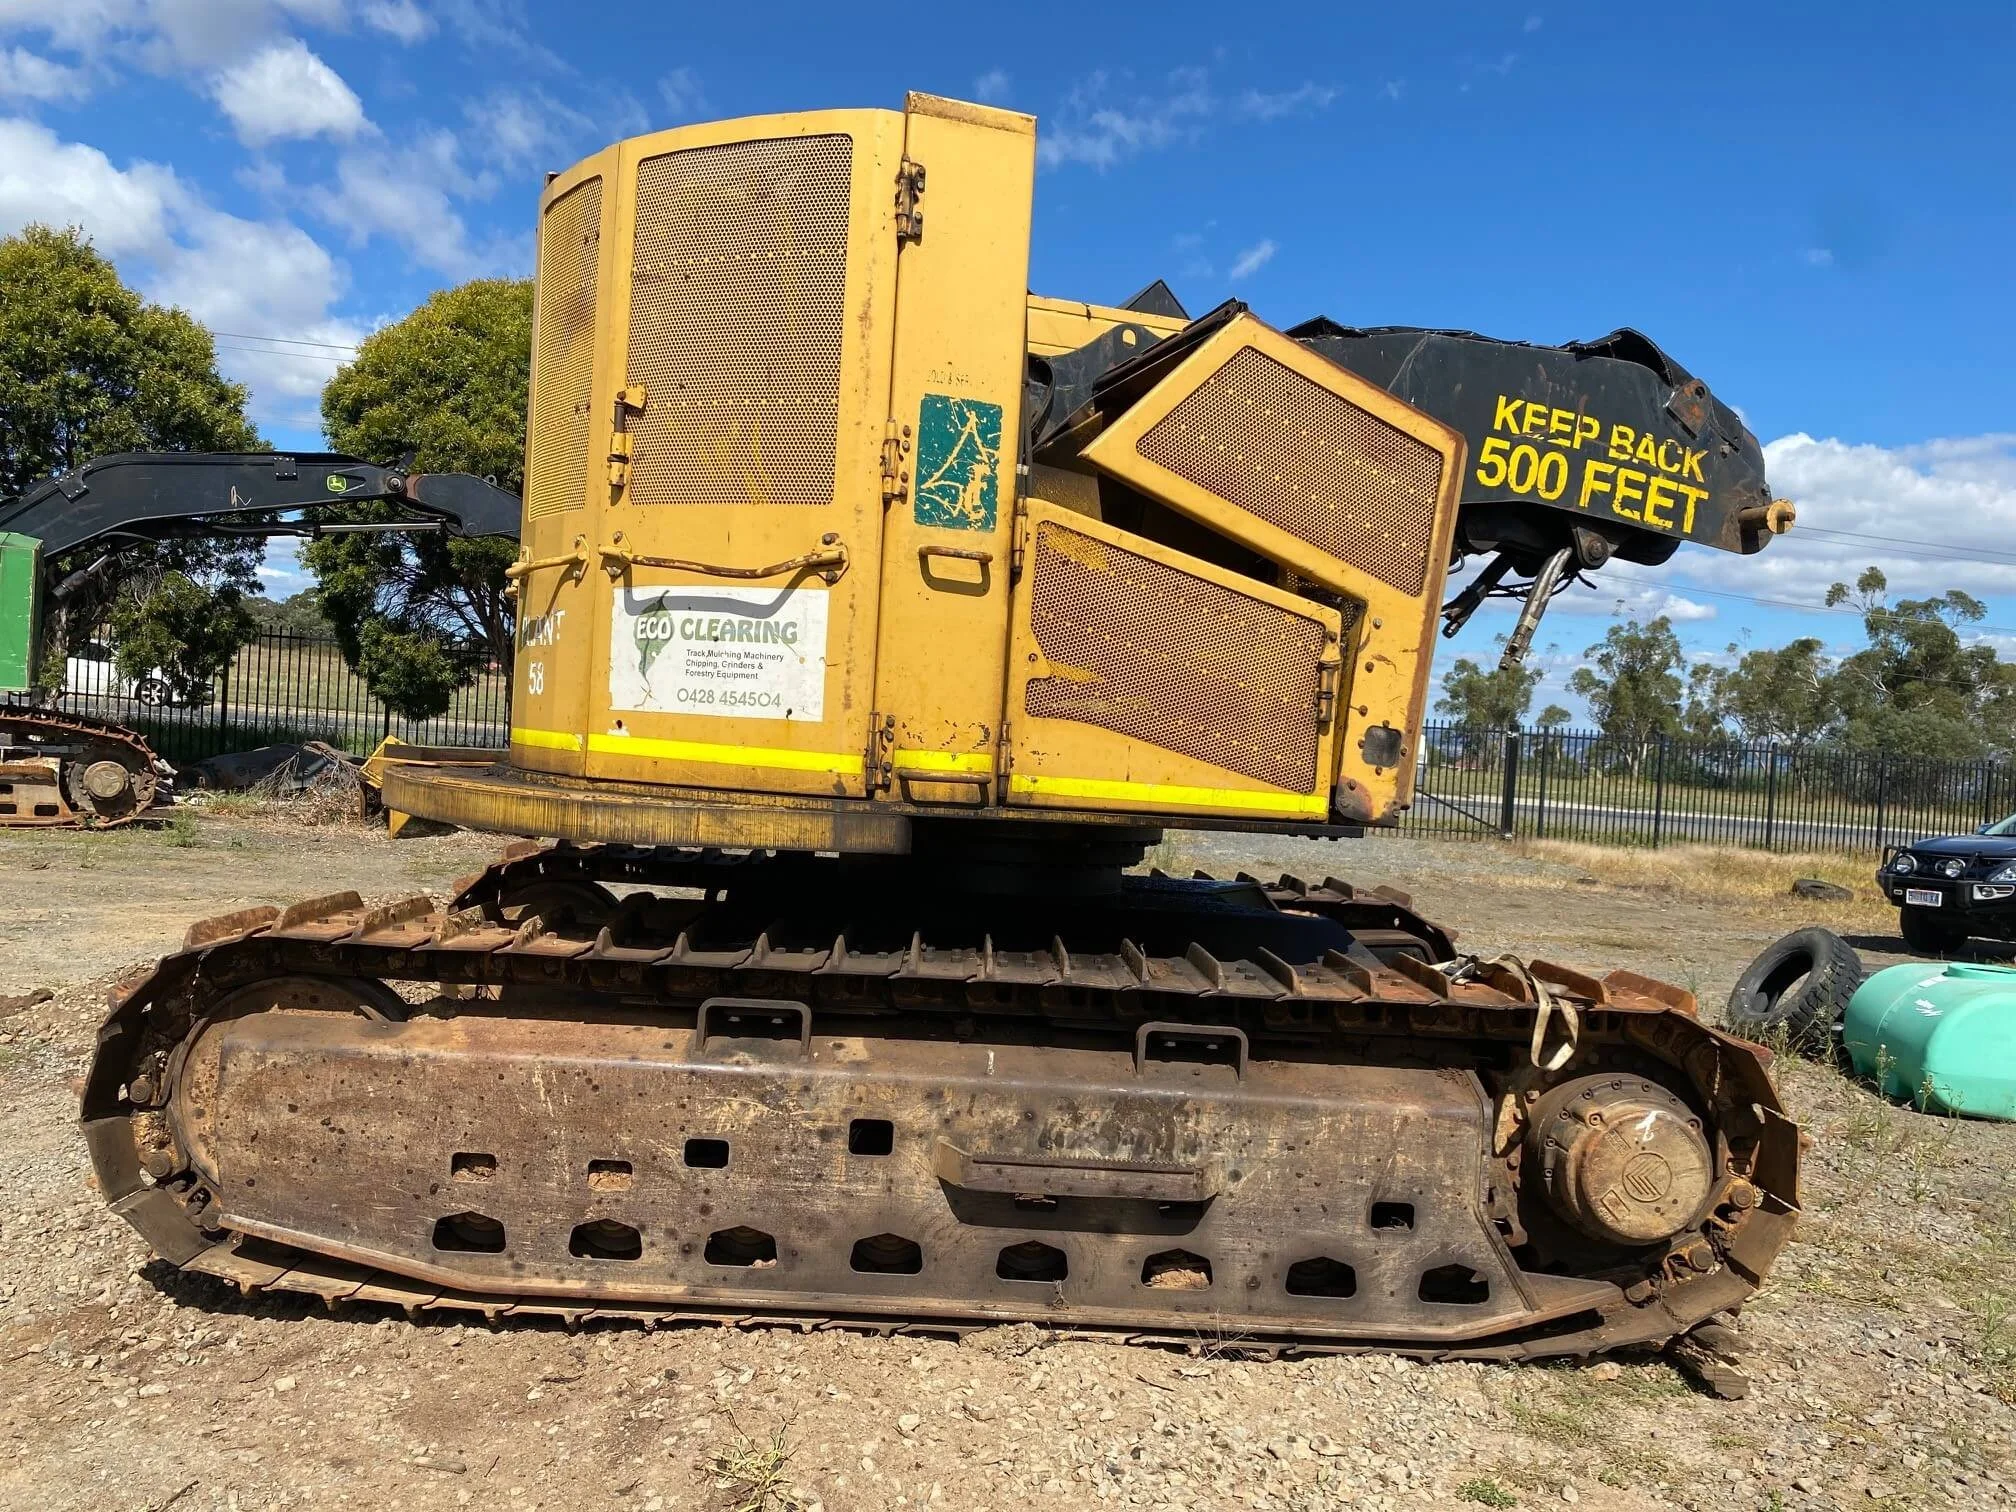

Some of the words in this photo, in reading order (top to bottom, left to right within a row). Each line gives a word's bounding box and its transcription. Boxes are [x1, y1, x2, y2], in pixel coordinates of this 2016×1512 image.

[1493, 395, 1601, 450] KEEP
[1609, 423, 1709, 483] BACK
[1476, 436, 1569, 500] 500
[1579, 459, 1709, 534] FEET
[635, 616, 673, 641] ECO
[680, 617, 798, 644] CLEARING
[721, 661, 755, 670] Grinders
[757, 662, 764, 670] &
[743, 651, 784, 662] Machinery
[528, 661, 544, 695] 58
[685, 669, 715, 678] Forestry
[716, 671, 759, 680] Equipment
[677, 688, 715, 704] 0428
[719, 690, 782, 708] 454504
